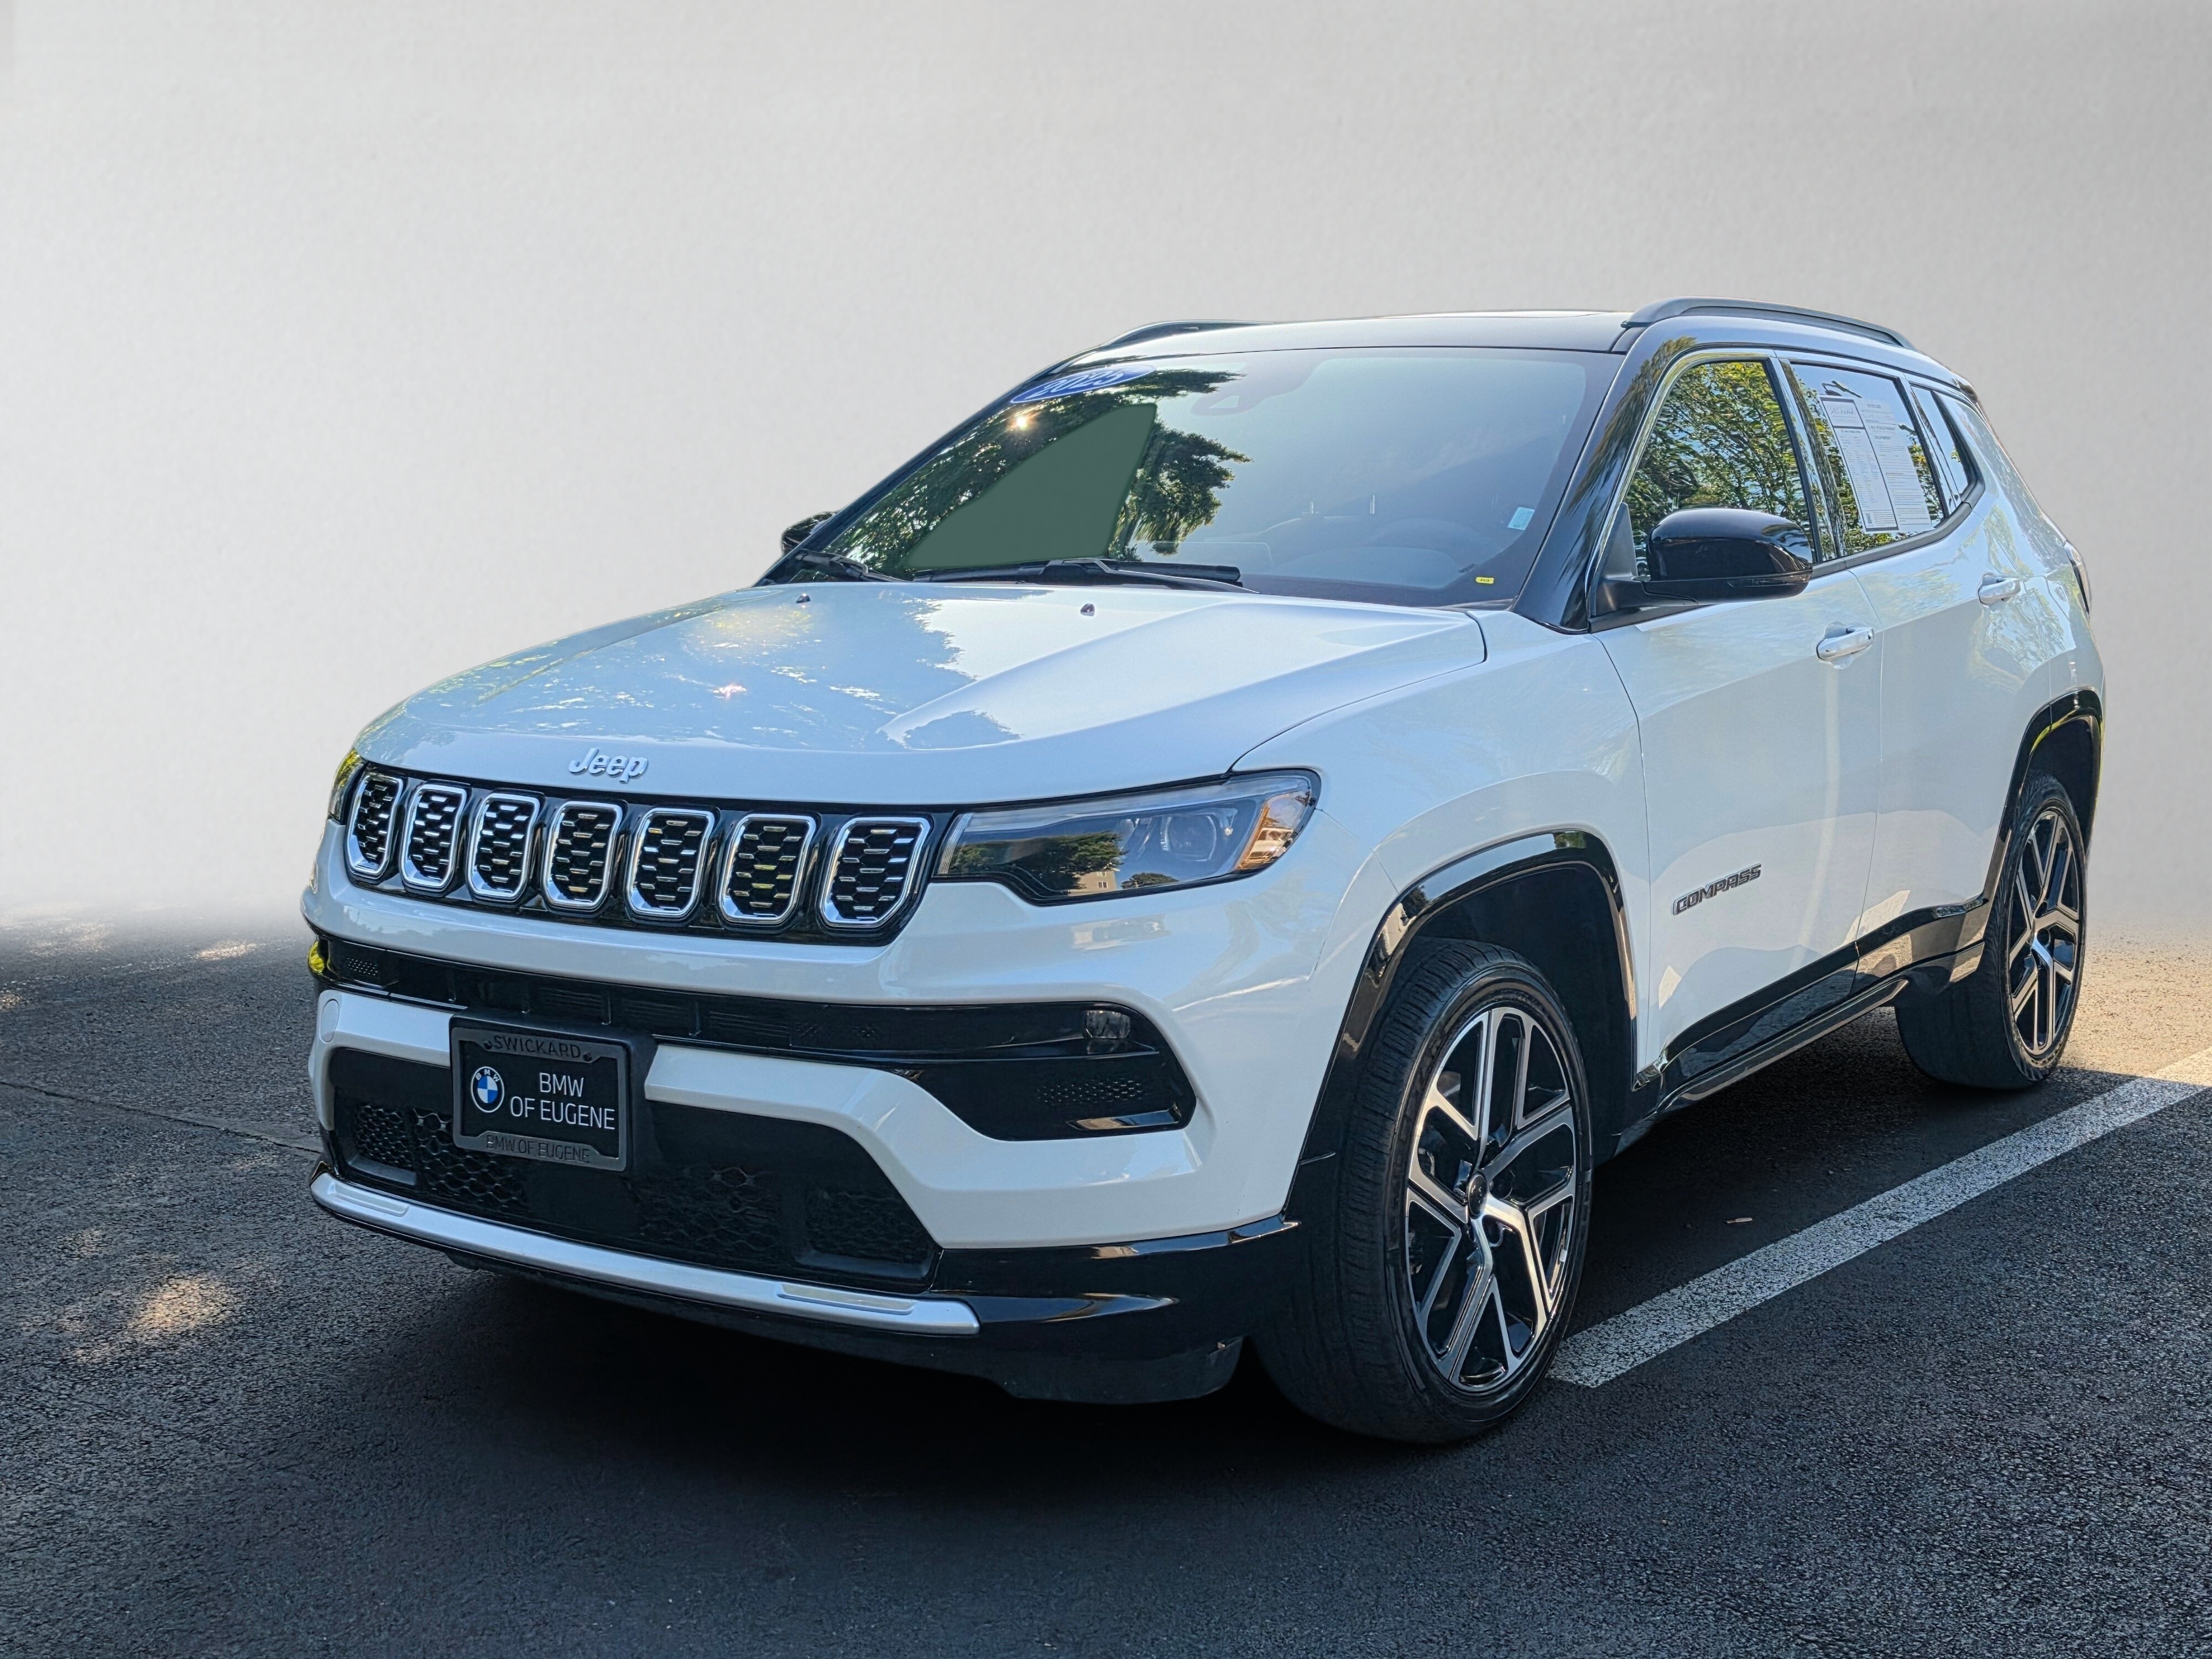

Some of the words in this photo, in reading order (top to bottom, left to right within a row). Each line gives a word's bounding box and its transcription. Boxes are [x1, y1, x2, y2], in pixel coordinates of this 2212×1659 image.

[1024, 369, 1126, 400] 2025
[568, 748, 648, 784] Jeep
[1673, 863, 1762, 916] COMPASS
[493, 1036, 581, 1058] SWICKARD
[476, 1068, 499, 1082] BMW
[539, 1072, 584, 1097] BMW
[510, 1096, 535, 1118] OF
[541, 1100, 615, 1130] EUGENE
[486, 1134, 515, 1151] BMW
[519, 1140, 536, 1154] OF
[539, 1142, 590, 1164] EUGENE
